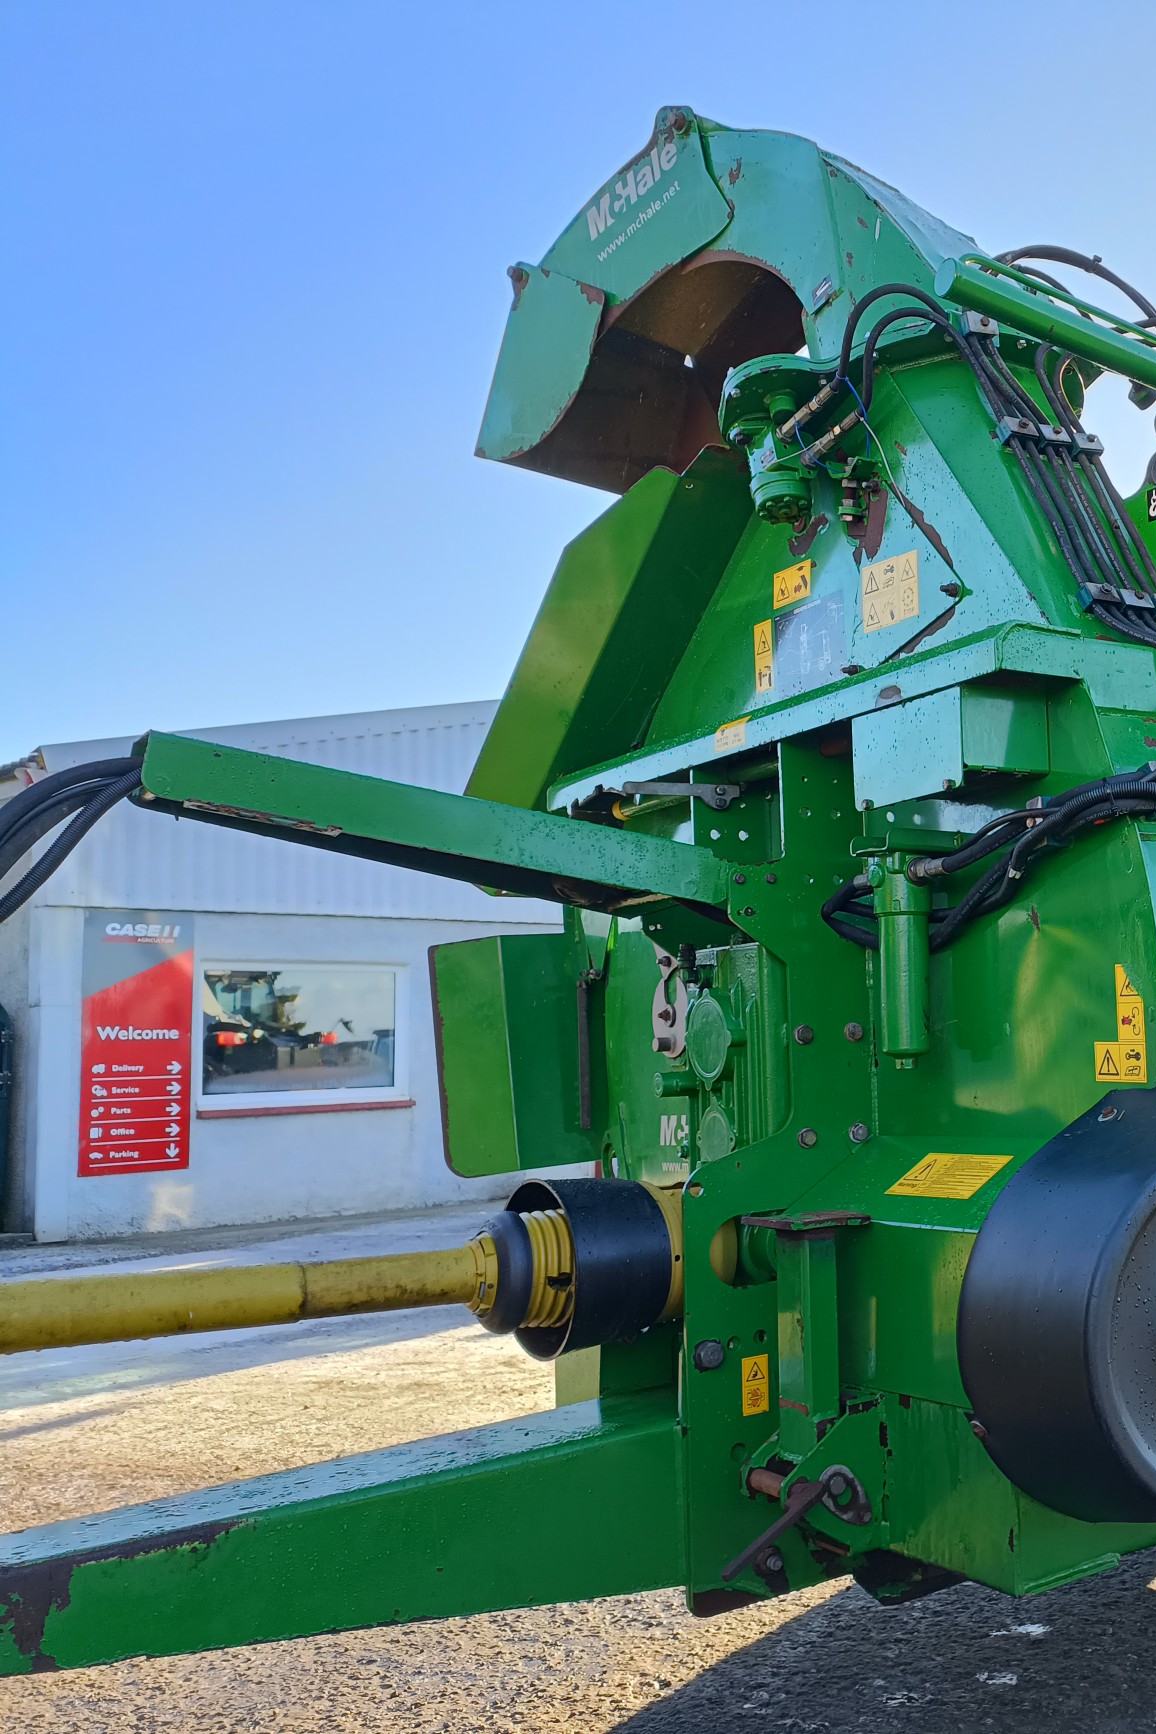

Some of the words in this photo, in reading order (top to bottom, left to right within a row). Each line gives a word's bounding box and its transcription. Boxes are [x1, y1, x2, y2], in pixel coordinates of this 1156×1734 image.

[586, 143, 677, 242] McHale
[597, 180, 681, 262] www.mchale.net
[104, 922, 162, 937] CASE
[97, 1025, 180, 1041] Welcome
[111, 1064, 144, 1073] Delivery
[111, 1085, 140, 1094] Service
[110, 1107, 132, 1115] Parts
[109, 1128, 135, 1136] Office
[109, 1150, 139, 1159] Parking
